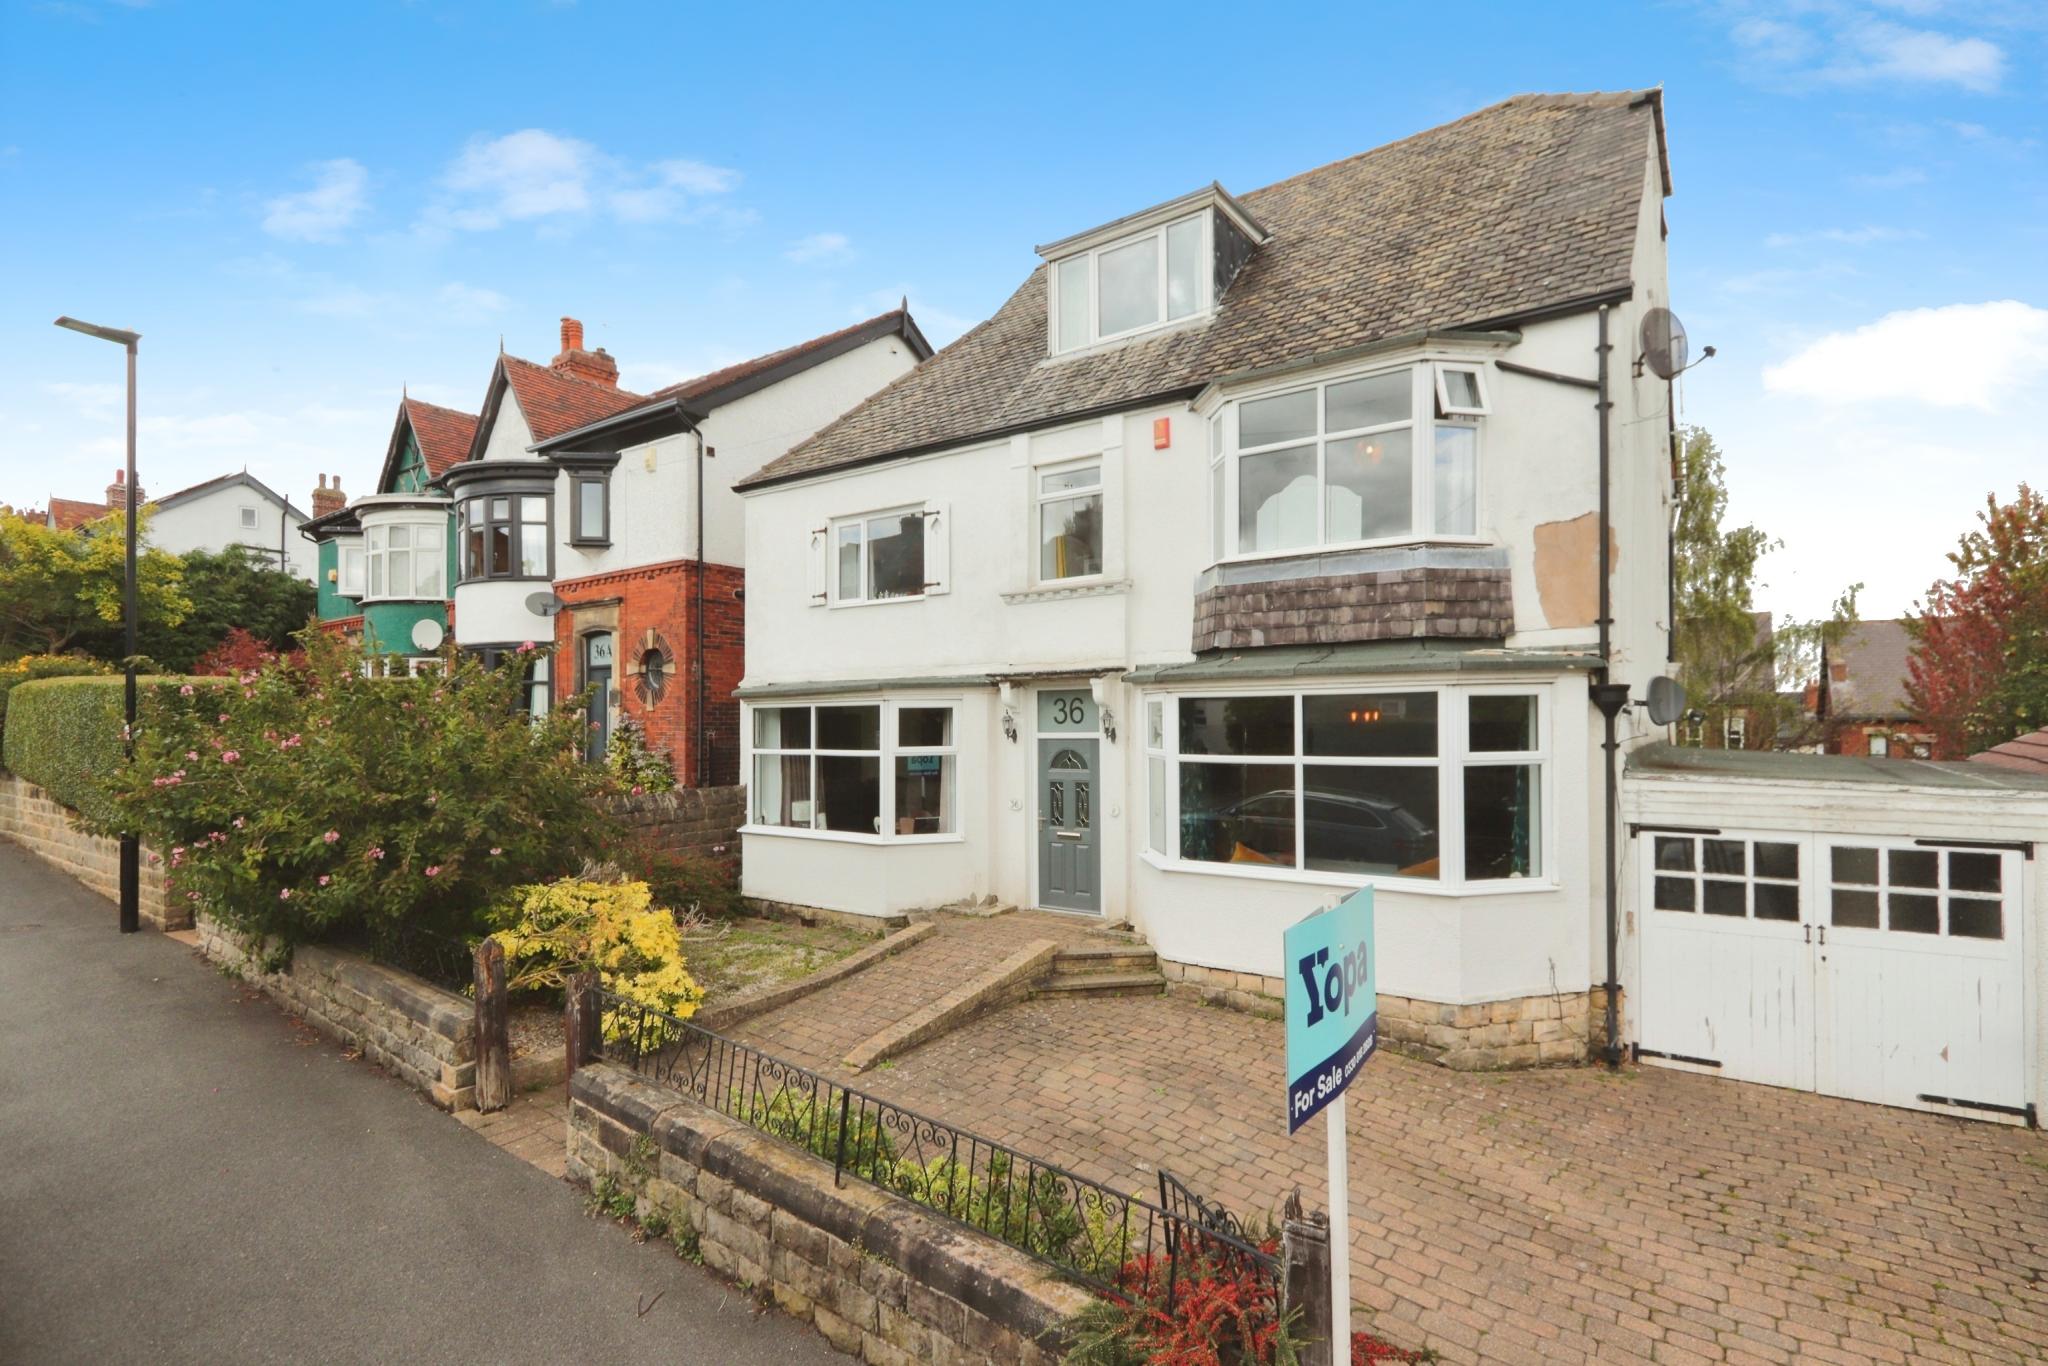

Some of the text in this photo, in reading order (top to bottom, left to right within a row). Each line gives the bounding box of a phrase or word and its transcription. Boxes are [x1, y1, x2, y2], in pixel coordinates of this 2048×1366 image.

[1053, 697, 1084, 725] 36
[1298, 940, 1367, 1028] Yopa
[1294, 1087, 1315, 1119] For
[1317, 1065, 1343, 1099] Sale
